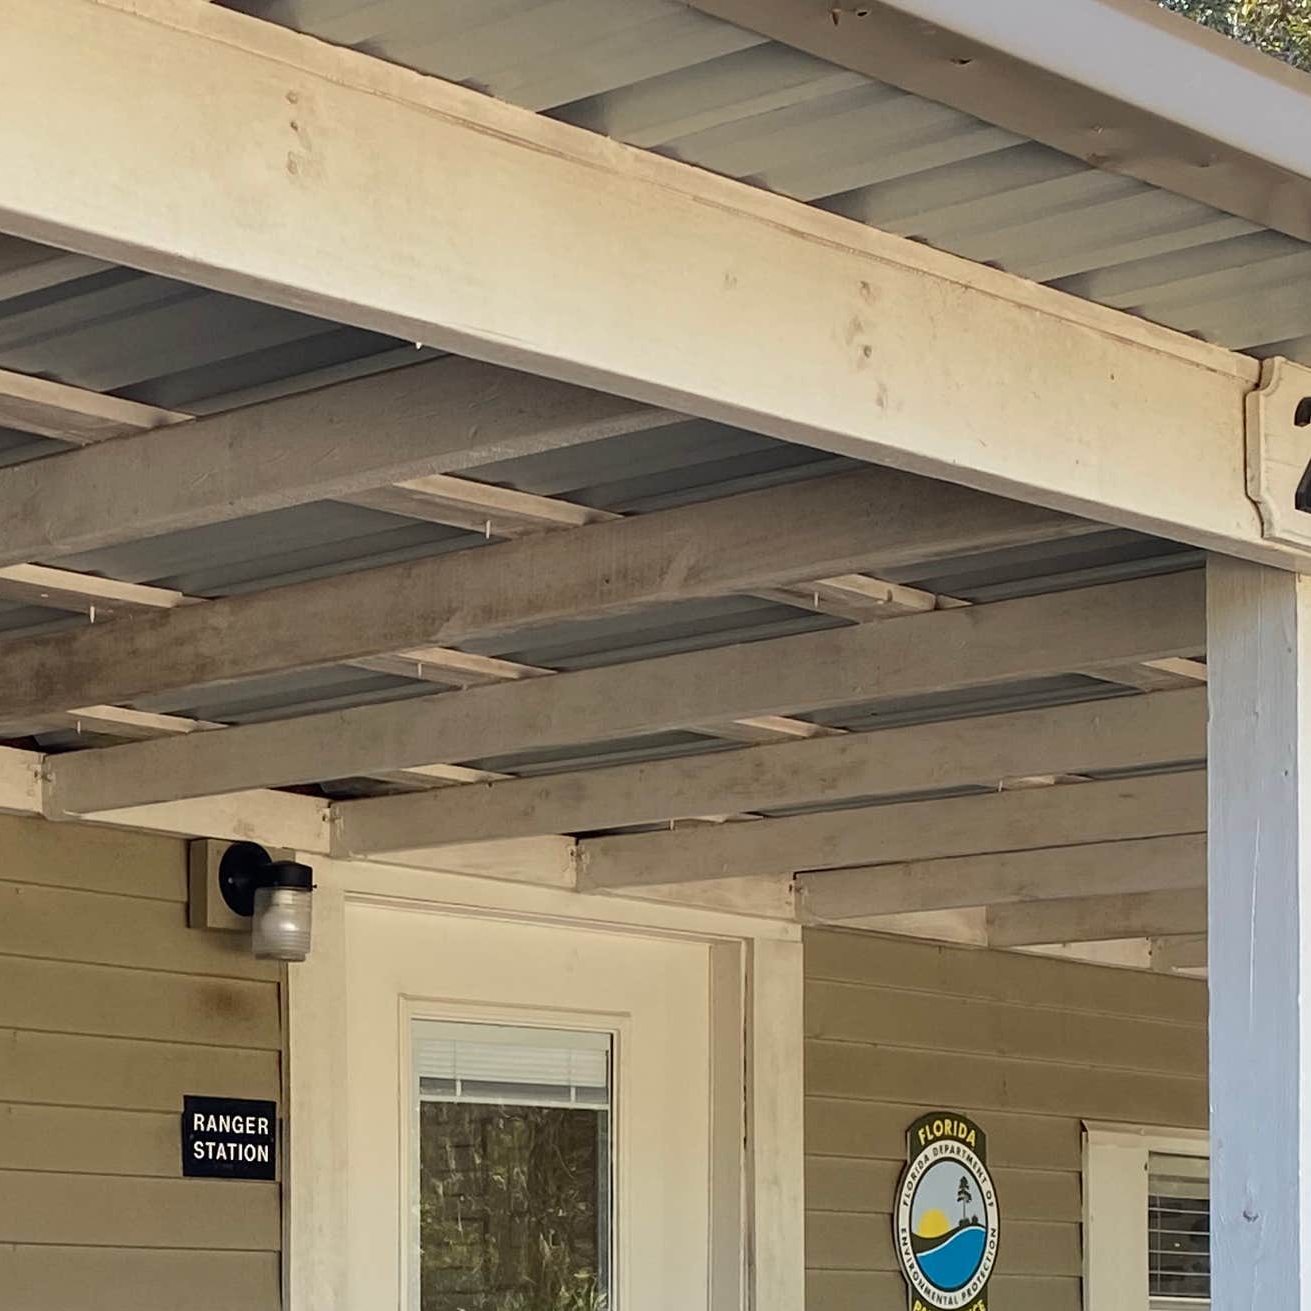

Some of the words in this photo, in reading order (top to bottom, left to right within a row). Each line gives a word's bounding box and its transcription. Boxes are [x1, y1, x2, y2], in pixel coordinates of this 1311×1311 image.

[193, 1113, 269, 1135] RANGER
[917, 1119, 977, 1147] FLORIDA
[193, 1140, 269, 1163] STATION
[902, 1154, 931, 1208] FLORIDA
[932, 1144, 988, 1185] DEPARTMENT
